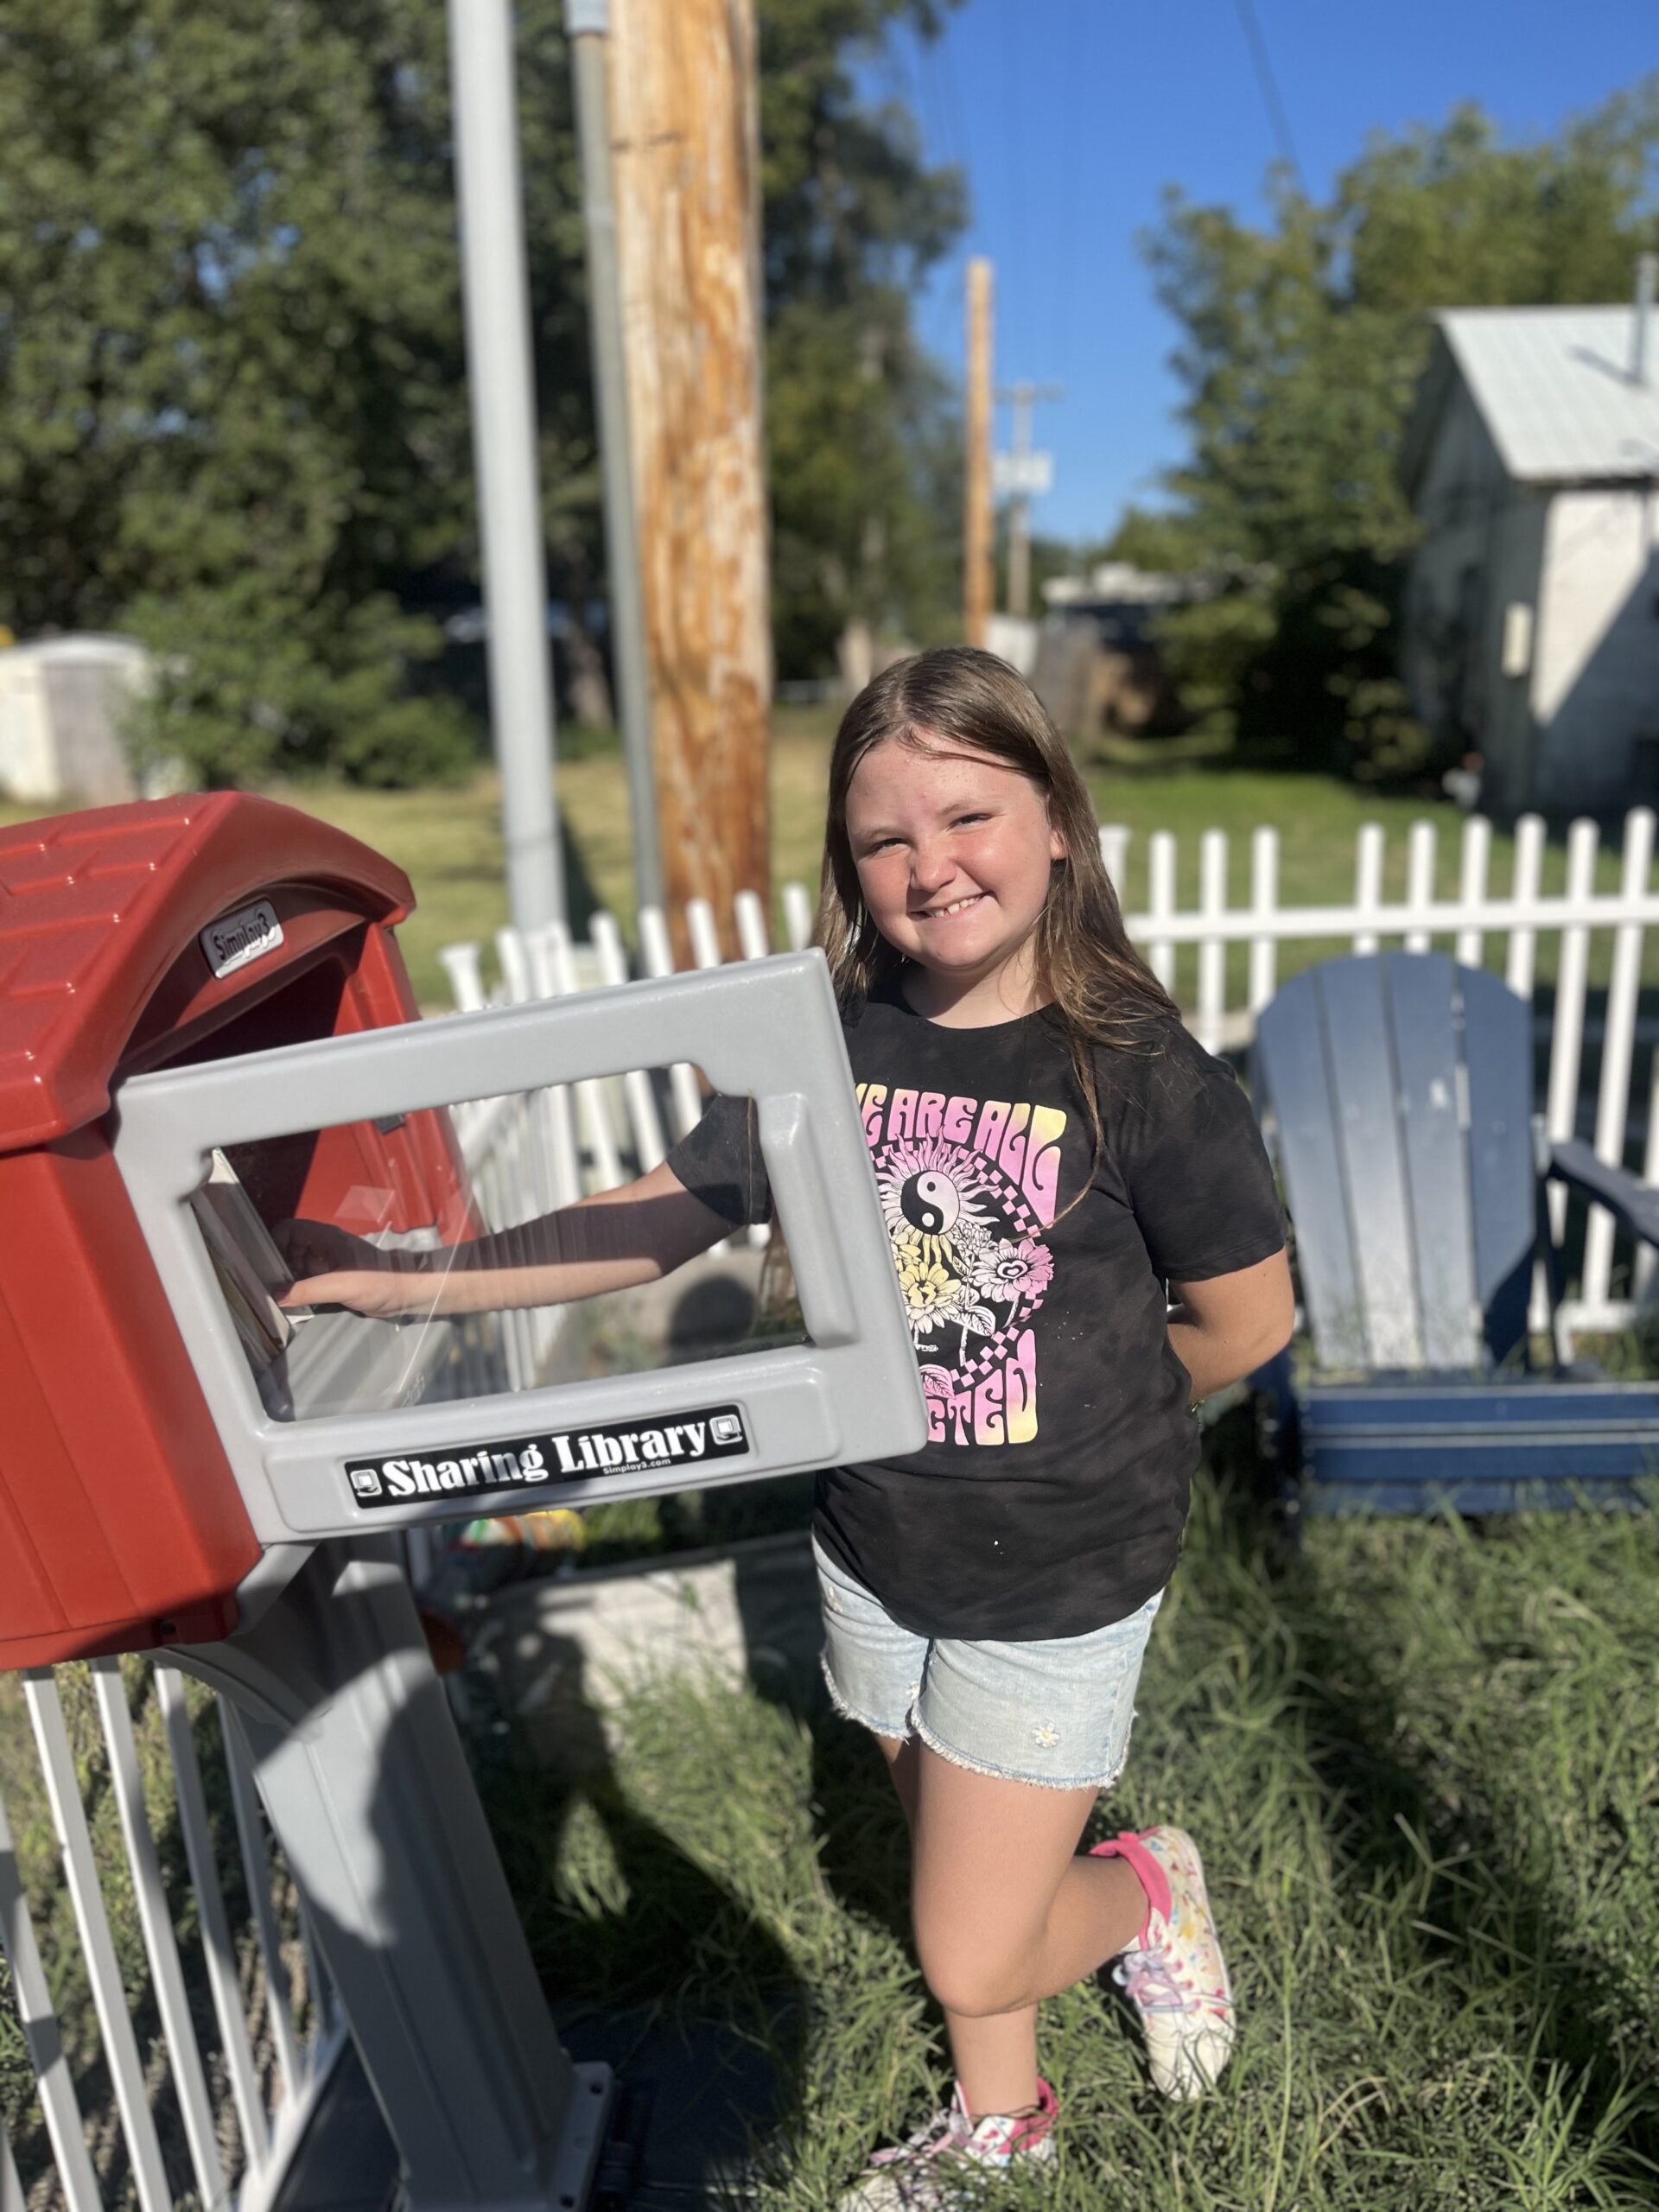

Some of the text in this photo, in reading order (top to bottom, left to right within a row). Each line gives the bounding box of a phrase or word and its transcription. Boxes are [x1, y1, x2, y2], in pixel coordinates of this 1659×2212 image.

[213, 912, 271, 962] Simplay3
[887, 1088, 977, 1144] ARE
[974, 1100, 1067, 1229] ALL
[926, 1328, 1038, 1446] CTED
[382, 1421, 705, 1498] Sharing Library
[603, 1459, 671, 1475] Simplay3.com
